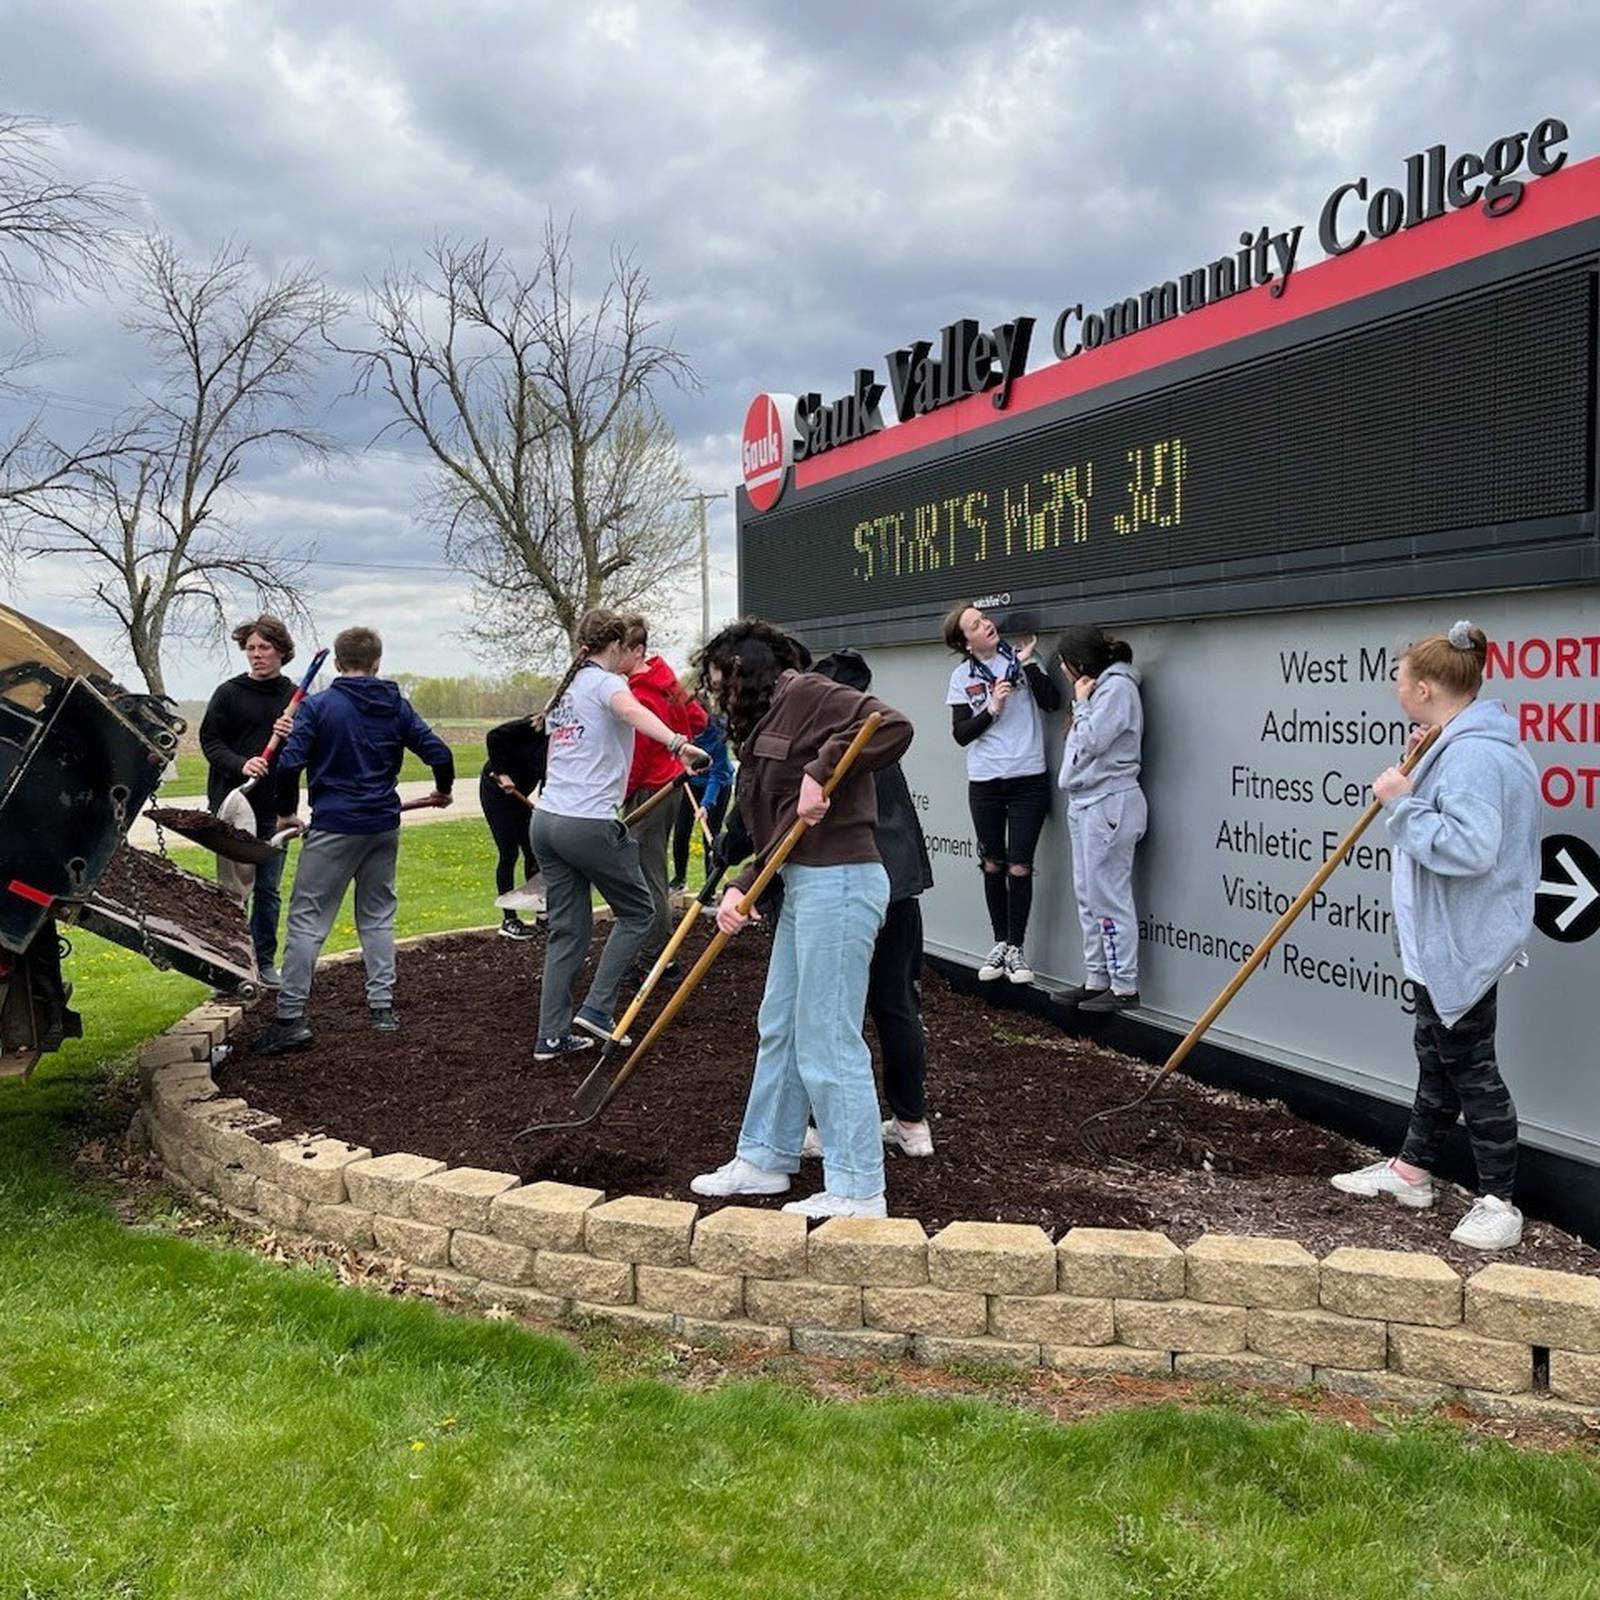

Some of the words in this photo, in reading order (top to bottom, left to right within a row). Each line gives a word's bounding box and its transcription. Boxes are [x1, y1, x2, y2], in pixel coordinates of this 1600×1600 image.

[793, 368, 886, 462] Sauk
[885, 316, 1036, 409] Valley
[1052, 225, 1302, 360] Community
[1318, 117, 1568, 255] College
[1113, 439, 1187, 535] 30
[1280, 650, 1348, 683] West
[1359, 647, 1400, 682] Ma
[1485, 637, 1600, 679] NORT
[1518, 703, 1600, 743] RKI
[1232, 766, 1313, 803] Fitness
[1322, 771, 1377, 808] Cen
[1541, 766, 1600, 810] OT
[924, 834, 973, 860] opment
[1216, 820, 1312, 862] Athletic
[1322, 831, 1392, 873] Even
[1223, 874, 1298, 916] Visito
[1139, 915, 1255, 964] aintenance
[1284, 944, 1417, 1015] Receiving
